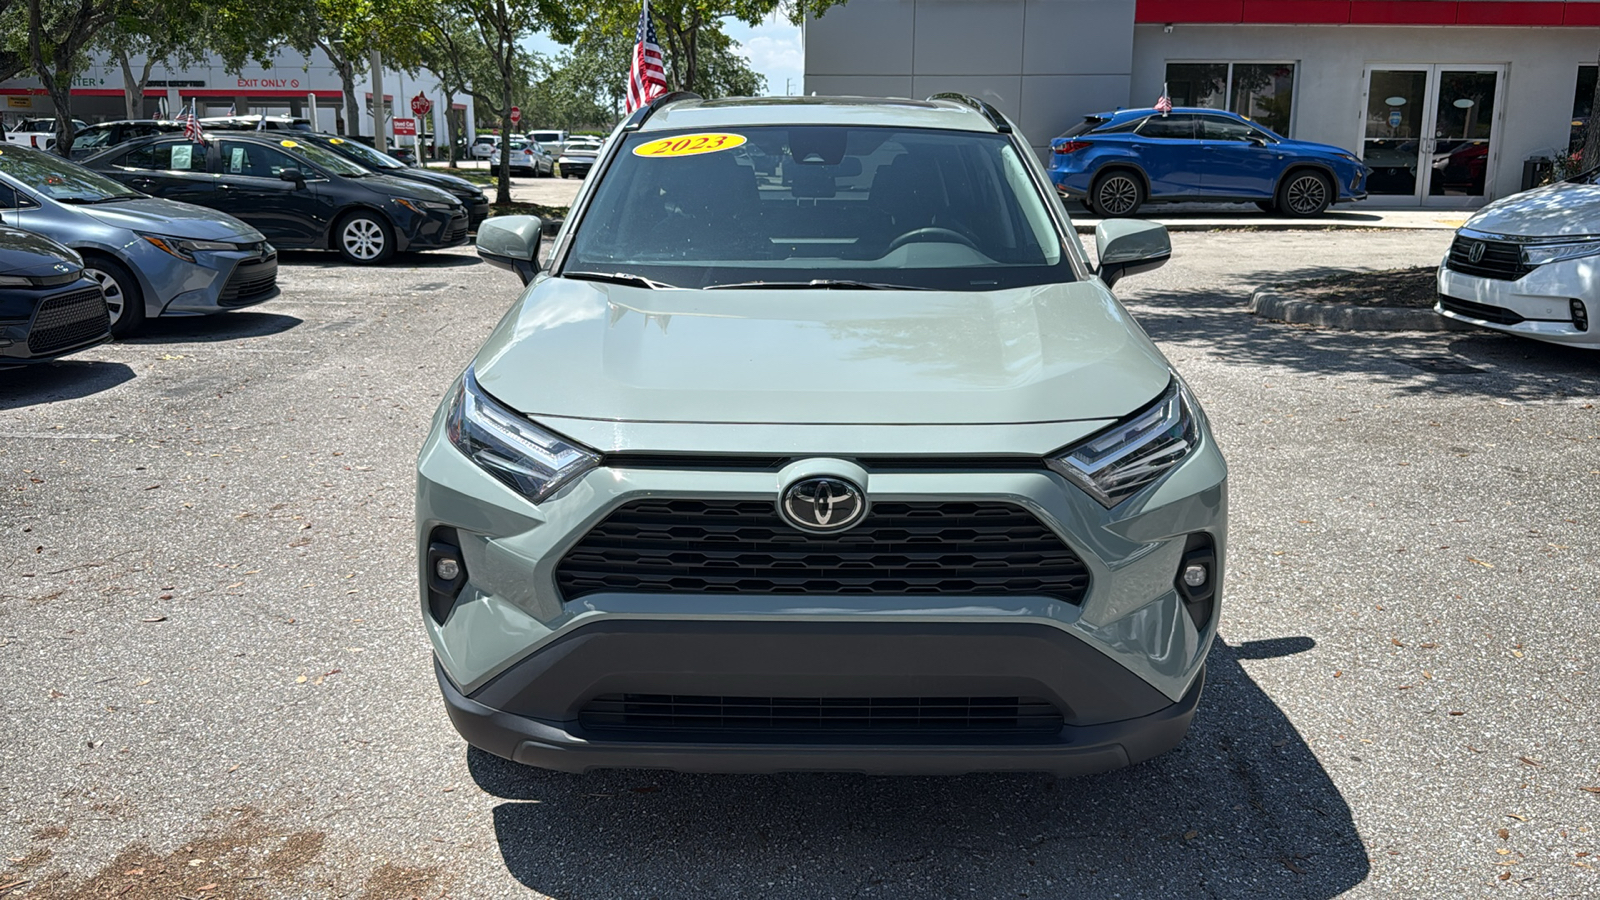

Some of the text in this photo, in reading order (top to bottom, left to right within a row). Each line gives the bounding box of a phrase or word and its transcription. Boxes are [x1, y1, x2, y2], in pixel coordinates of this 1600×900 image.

[237, 79, 287, 87] EXIT ONLY
[651, 136, 728, 154] 2023
